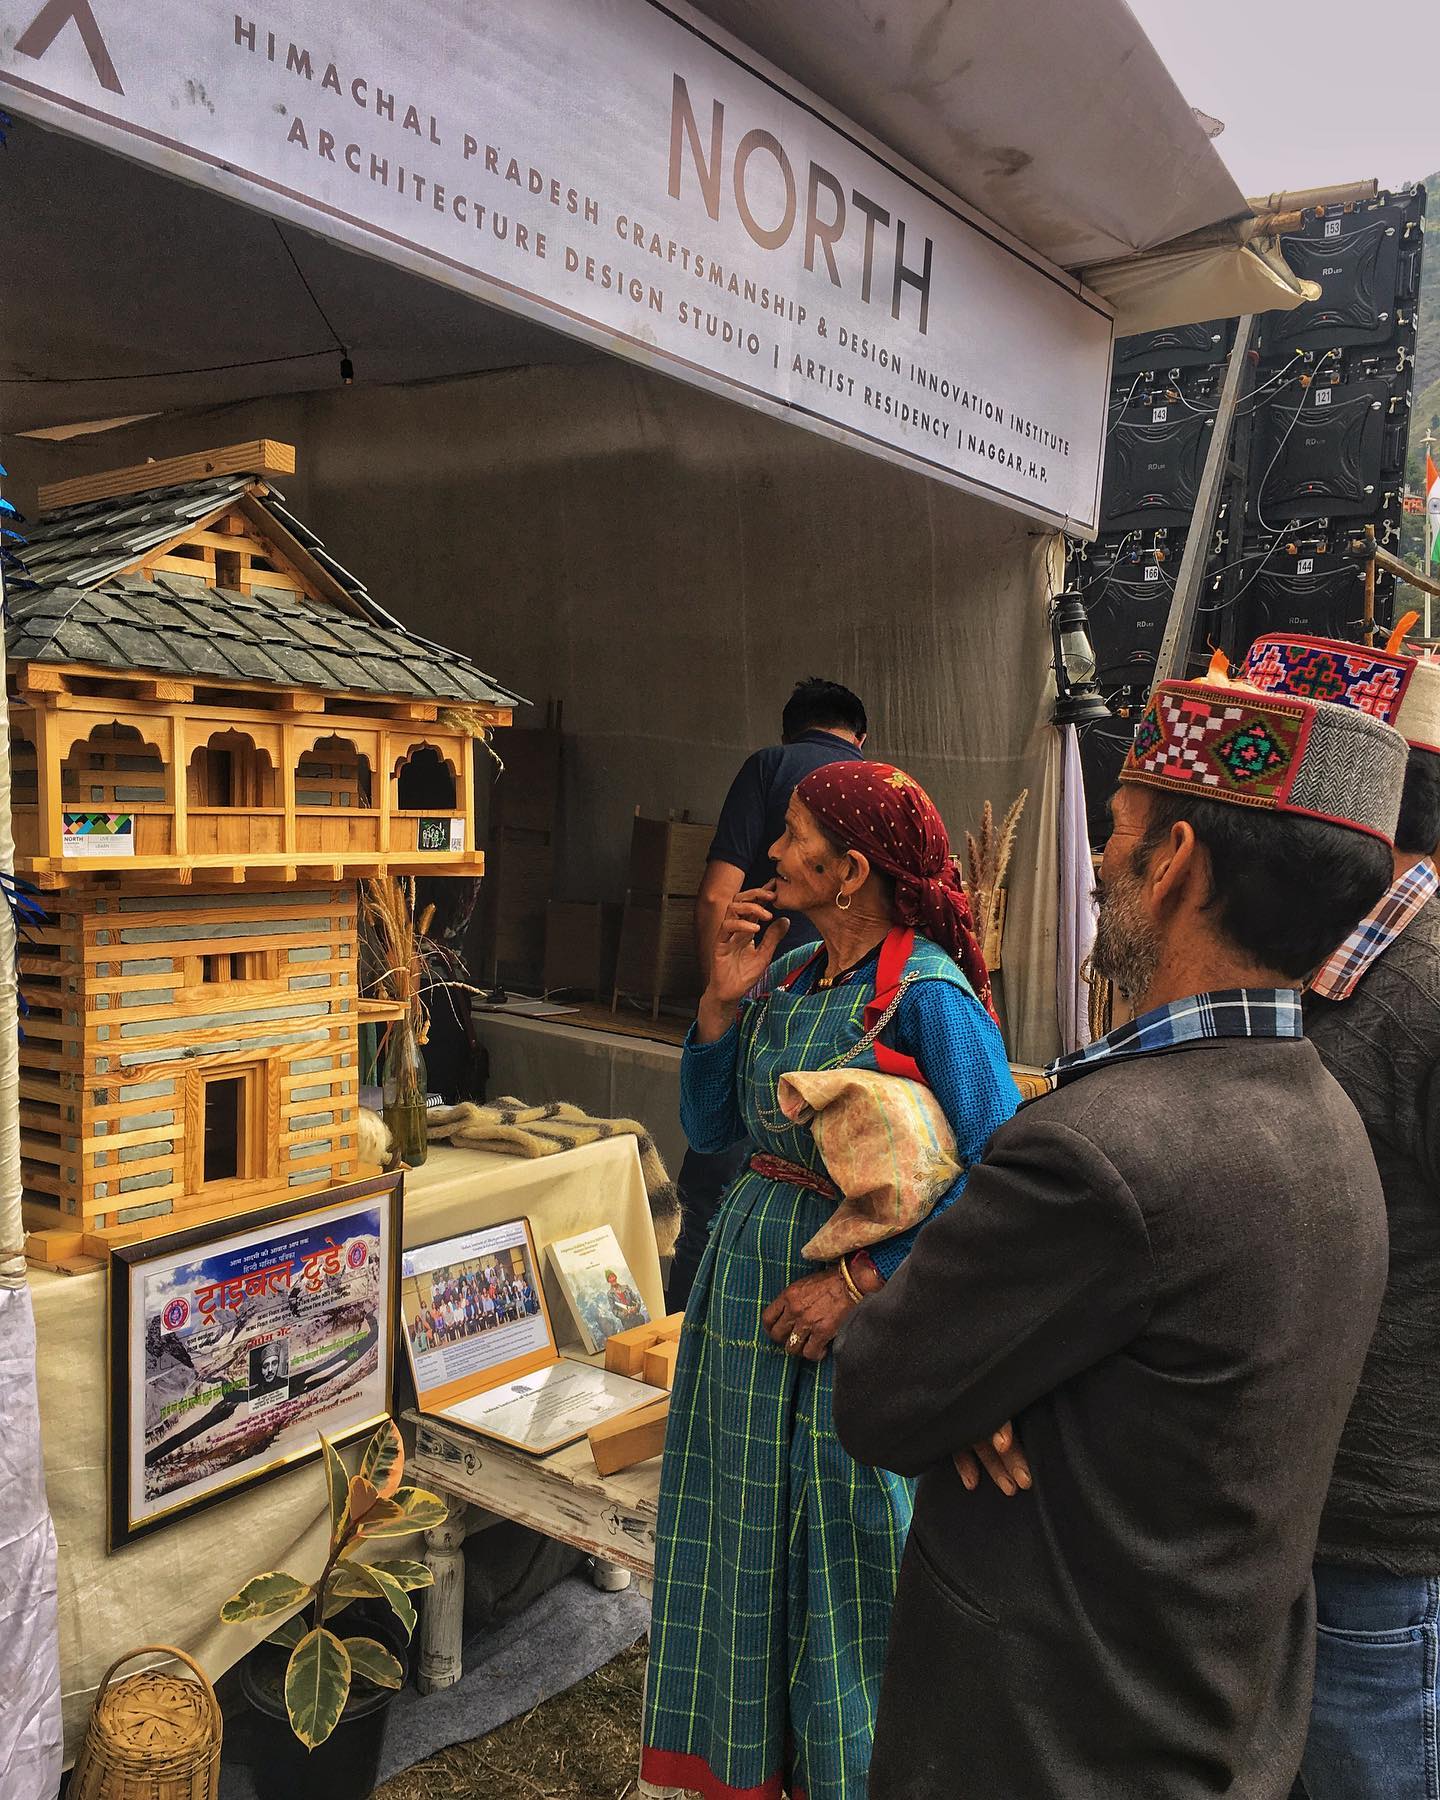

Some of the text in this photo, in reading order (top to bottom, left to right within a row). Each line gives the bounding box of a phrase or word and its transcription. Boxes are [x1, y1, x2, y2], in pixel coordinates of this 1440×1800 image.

[667, 72, 933, 336] NORTH
[234, 14, 1070, 456] HIMACHAL PRADESH CRAFTSMANSHIP & DESIGN INNOVATION INSTITUTE
[1326, 223, 1340, 235] 153
[287, 116, 546, 259] ARCHITECTURE
[565, 246, 663, 313] DESIGN
[678, 301, 760, 355] STUDIO
[792, 353, 855, 397] ARTIST
[864, 386, 950, 439] RESIDENCY
[1322, 267, 1333, 276] RD
[1317, 391, 1331, 403] 121
[1154, 409, 1167, 422] 143
[1298, 560, 1312, 572] 144
[1145, 568, 1158, 580] 166
[301, 1236, 345, 1293] टुडे
